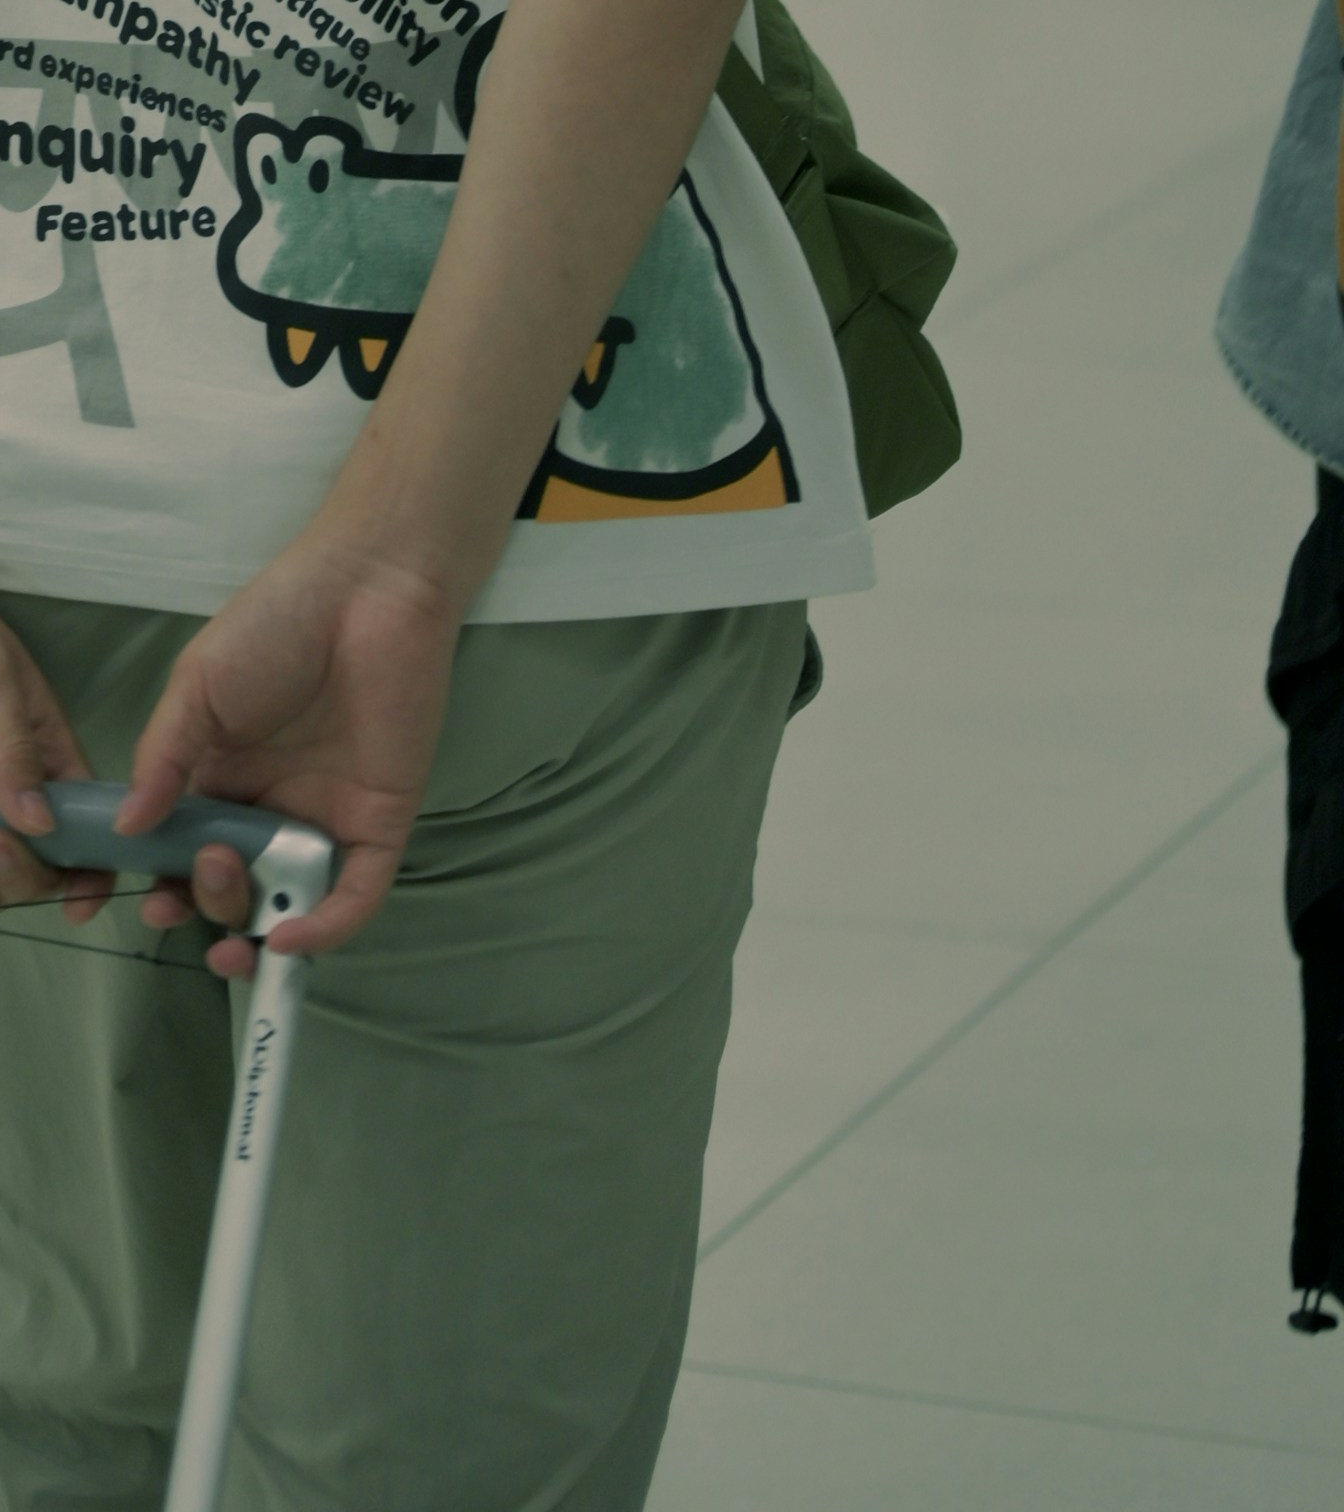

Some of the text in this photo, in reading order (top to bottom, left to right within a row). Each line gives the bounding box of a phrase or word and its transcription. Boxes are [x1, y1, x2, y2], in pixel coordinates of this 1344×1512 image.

[39, 54, 227, 134] experiences
[280, 34, 417, 126] review
[36, 204, 217, 243] Feature
